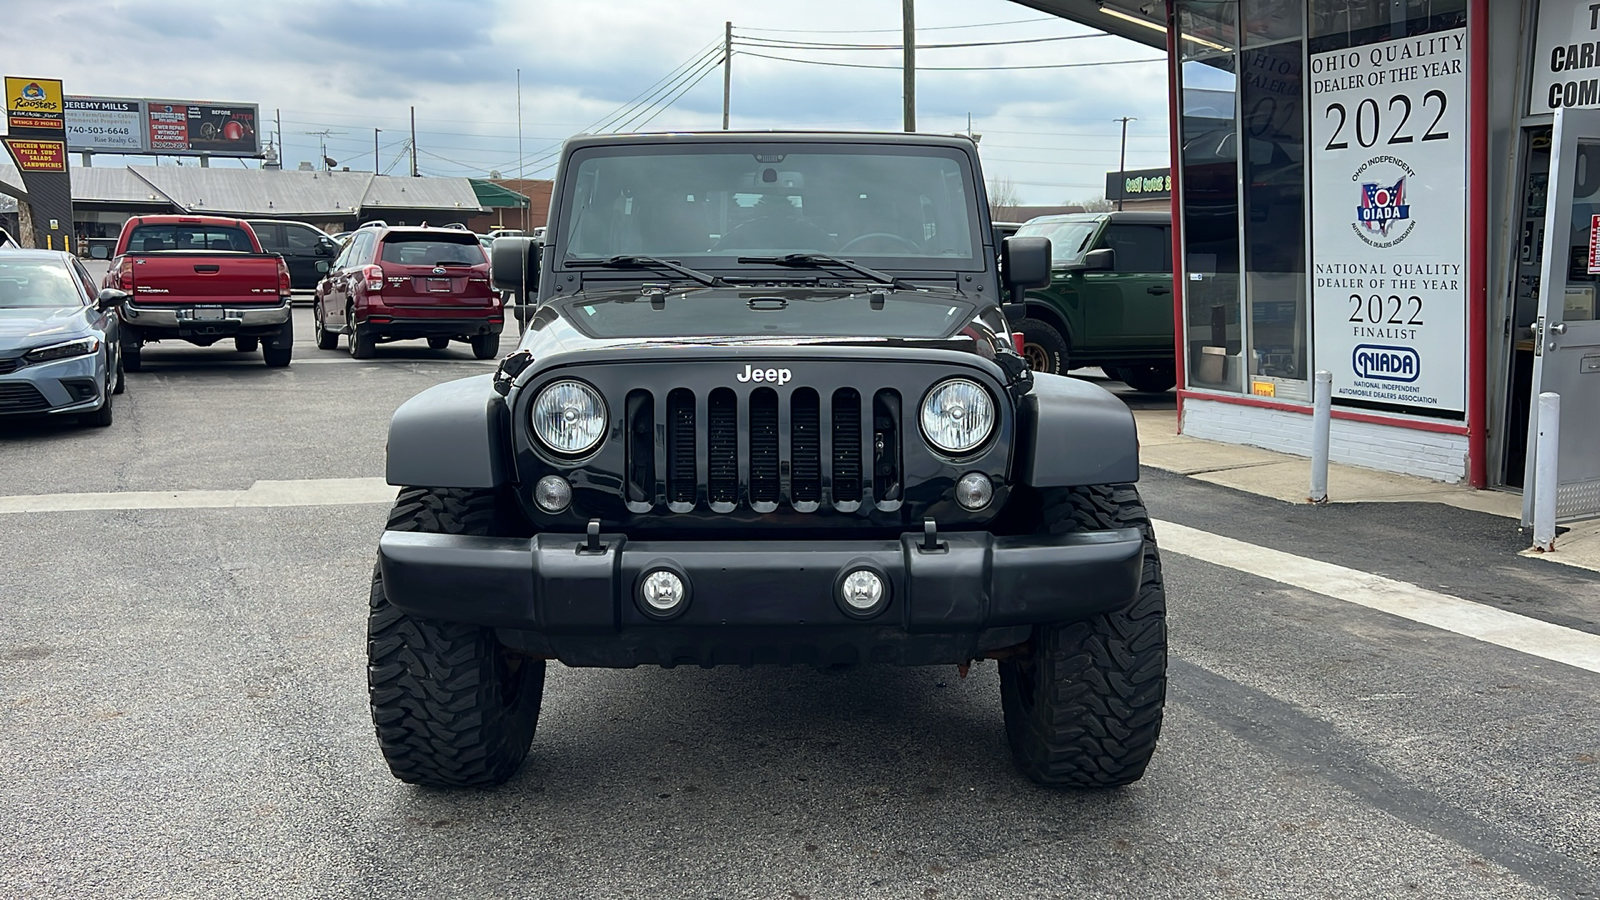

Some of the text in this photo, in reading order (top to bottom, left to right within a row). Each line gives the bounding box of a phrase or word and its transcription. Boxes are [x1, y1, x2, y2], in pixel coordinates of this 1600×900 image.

[1312, 33, 1465, 74] OHIO QUALITY
[1314, 74, 1365, 94] DEALER
[1368, 71, 1386, 86] OF
[1389, 66, 1418, 83] THE
[1422, 59, 1462, 78] YEAR
[1548, 79, 1600, 109] COM
[13, 97, 58, 110] Roosters
[64, 101, 129, 110] JEREMY MILLS
[1325, 89, 1449, 151] 2022
[67, 126, 129, 135] 740-503-6648
[110, 137, 126, 145] Realty
[1351, 155, 1416, 182] OHIO INDEPENDENT
[1363, 207, 1400, 220] OIADA
[1351, 220, 1416, 249] AUTOMOBILE DEALERS ASSOCIATION
[1316, 263, 1460, 276] NATIONAL QUALITY
[1317, 278, 1458, 290] DEALER OF THE YEAR
[1348, 294, 1424, 325] 2022
[1353, 326, 1417, 340] FINALIST
[1358, 351, 1413, 375] NIADA
[736, 364, 792, 386] Jeep
[1353, 381, 1420, 393] NATIONAL INDEPENDENT
[1339, 388, 1437, 404] AUTOMOBILE DEALERS ASSOCIATION
